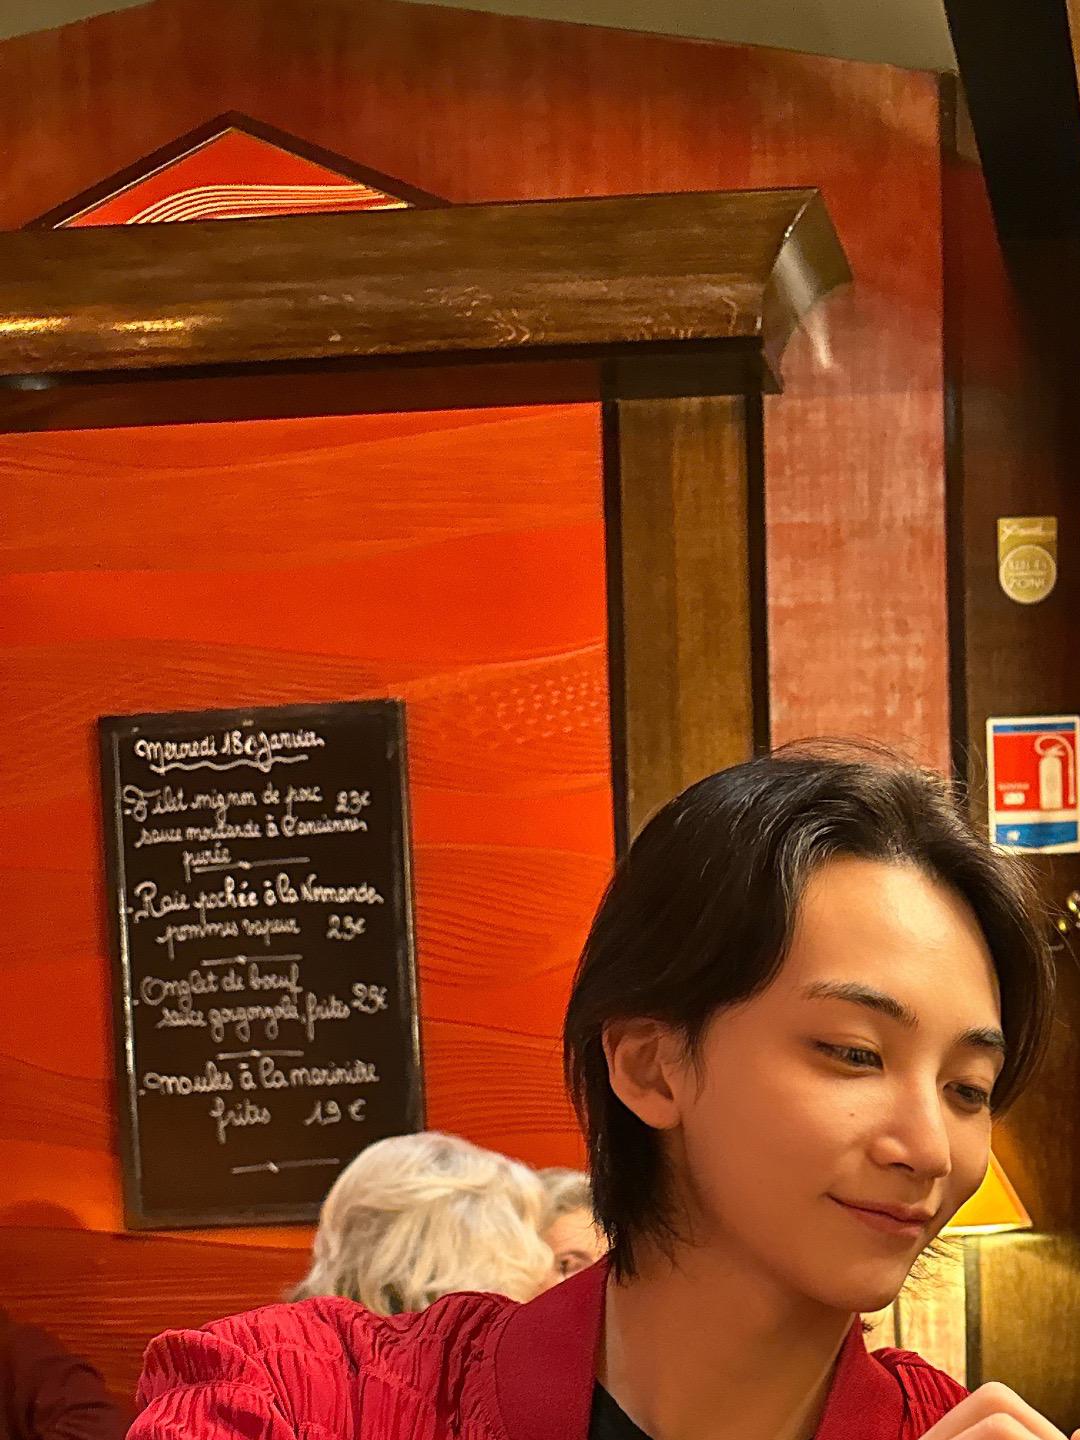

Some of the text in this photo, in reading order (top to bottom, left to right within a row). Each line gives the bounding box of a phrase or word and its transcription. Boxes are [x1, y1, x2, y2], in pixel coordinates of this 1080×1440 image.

[190, 788, 258, 830] mignon
[262, 781, 280, 805] de
[284, 784, 323, 816] porc
[134, 827, 183, 849] sauce
[185, 820, 263, 842] moutarde
[264, 813, 280, 838] à
[133, 880, 191, 924] Raie
[193, 875, 260, 927] pochée
[263, 879, 277, 907] à
[275, 872, 300, 904] la
[155, 922, 240, 961] pommes
[240, 918, 301, 947] vapeur
[140, 969, 220, 1012] Onglet
[222, 966, 245, 991] de
[239, 1062, 257, 1091] à
[259, 1056, 290, 1089] la
[208, 1096, 272, 1145] frites
